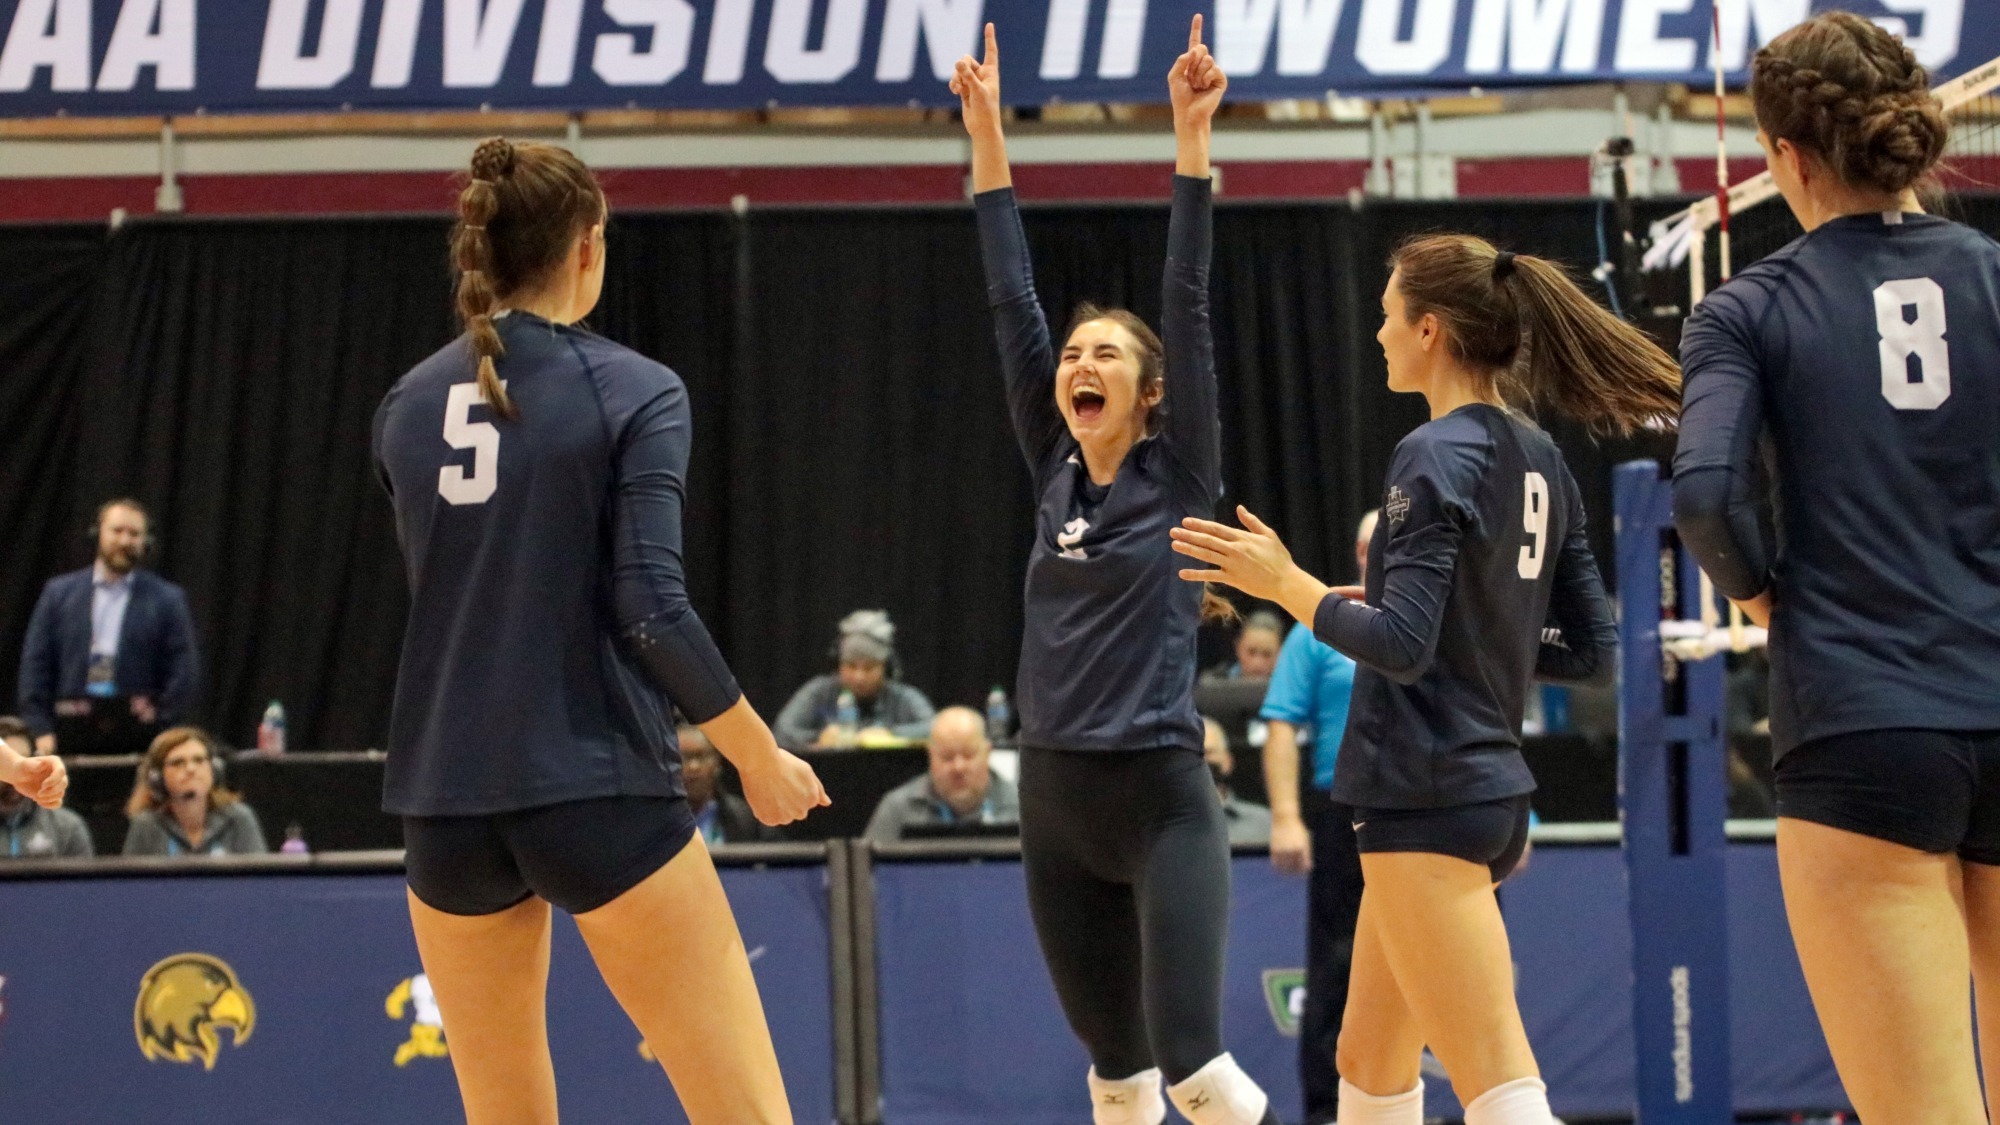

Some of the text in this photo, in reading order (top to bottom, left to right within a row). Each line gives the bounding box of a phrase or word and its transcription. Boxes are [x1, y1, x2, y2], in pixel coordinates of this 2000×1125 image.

[1212, 0, 1966, 77] WOMENS
[1872, 276, 1952, 410] 8
[438, 379, 507, 506] 5
[1517, 471, 1549, 579] 9
